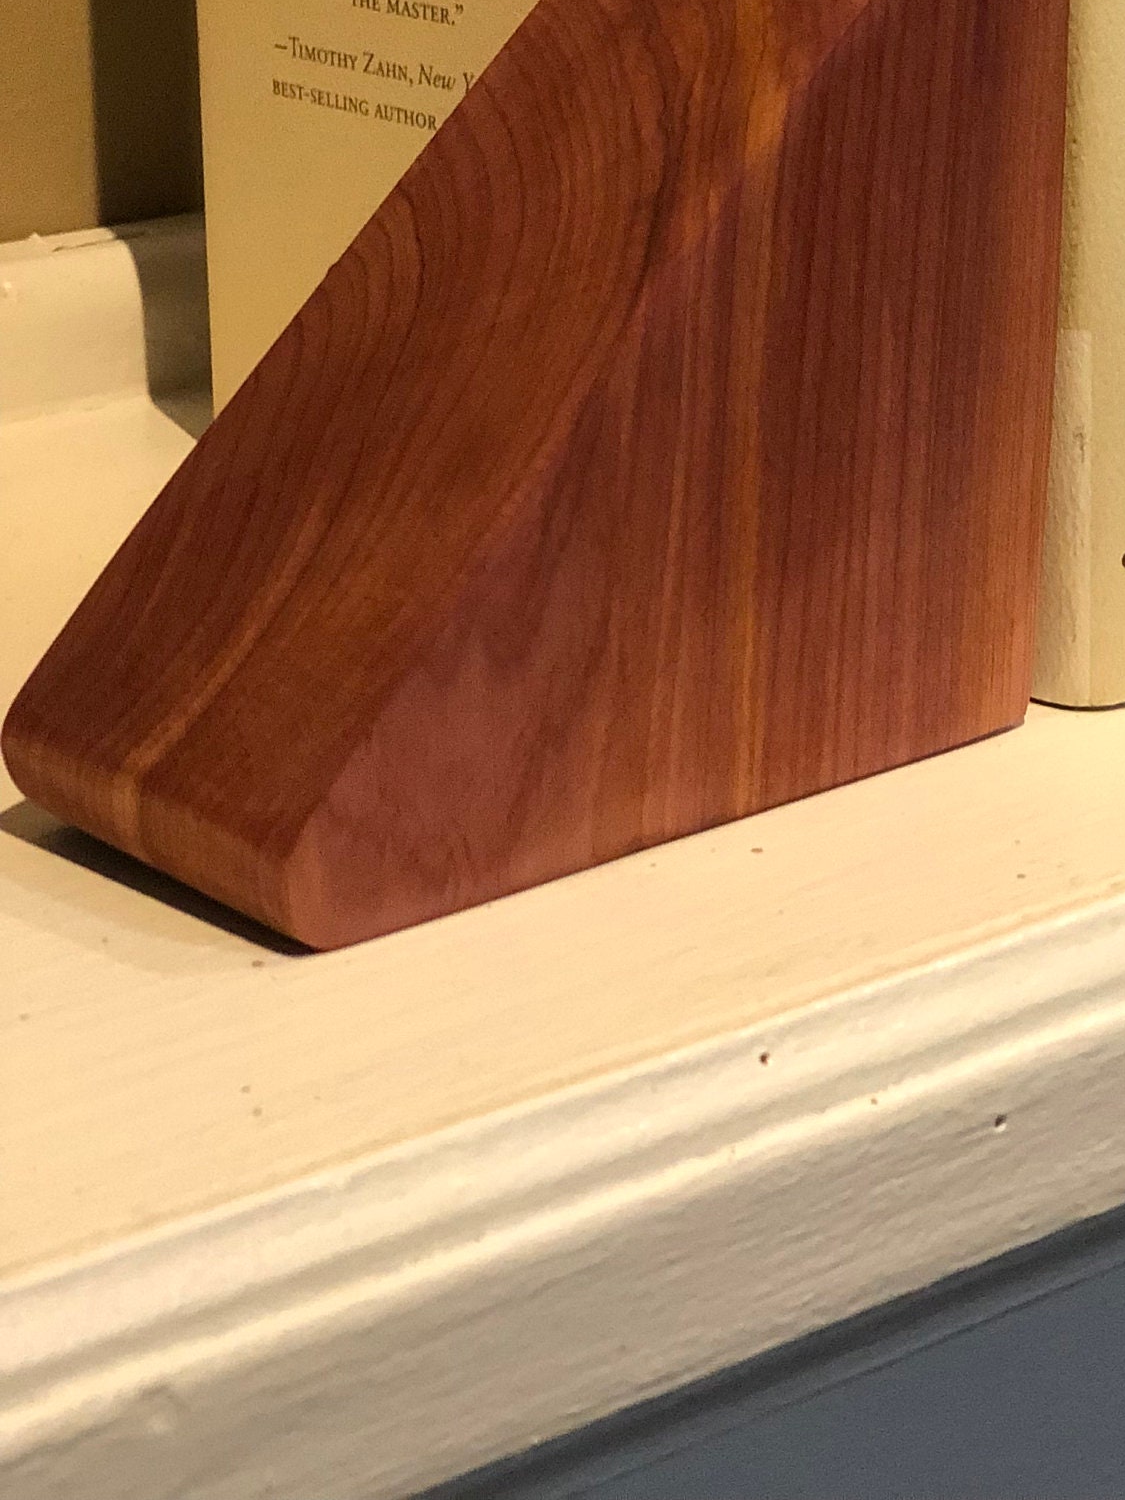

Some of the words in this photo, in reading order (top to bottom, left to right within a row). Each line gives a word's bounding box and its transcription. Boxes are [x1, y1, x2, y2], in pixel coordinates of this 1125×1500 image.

[363, 51, 414, 87] ZAHN,
[418, 63, 456, 90] New
[272, 78, 369, 116] BEST-SELLING
[375, 104, 437, 130] AUTHOR
